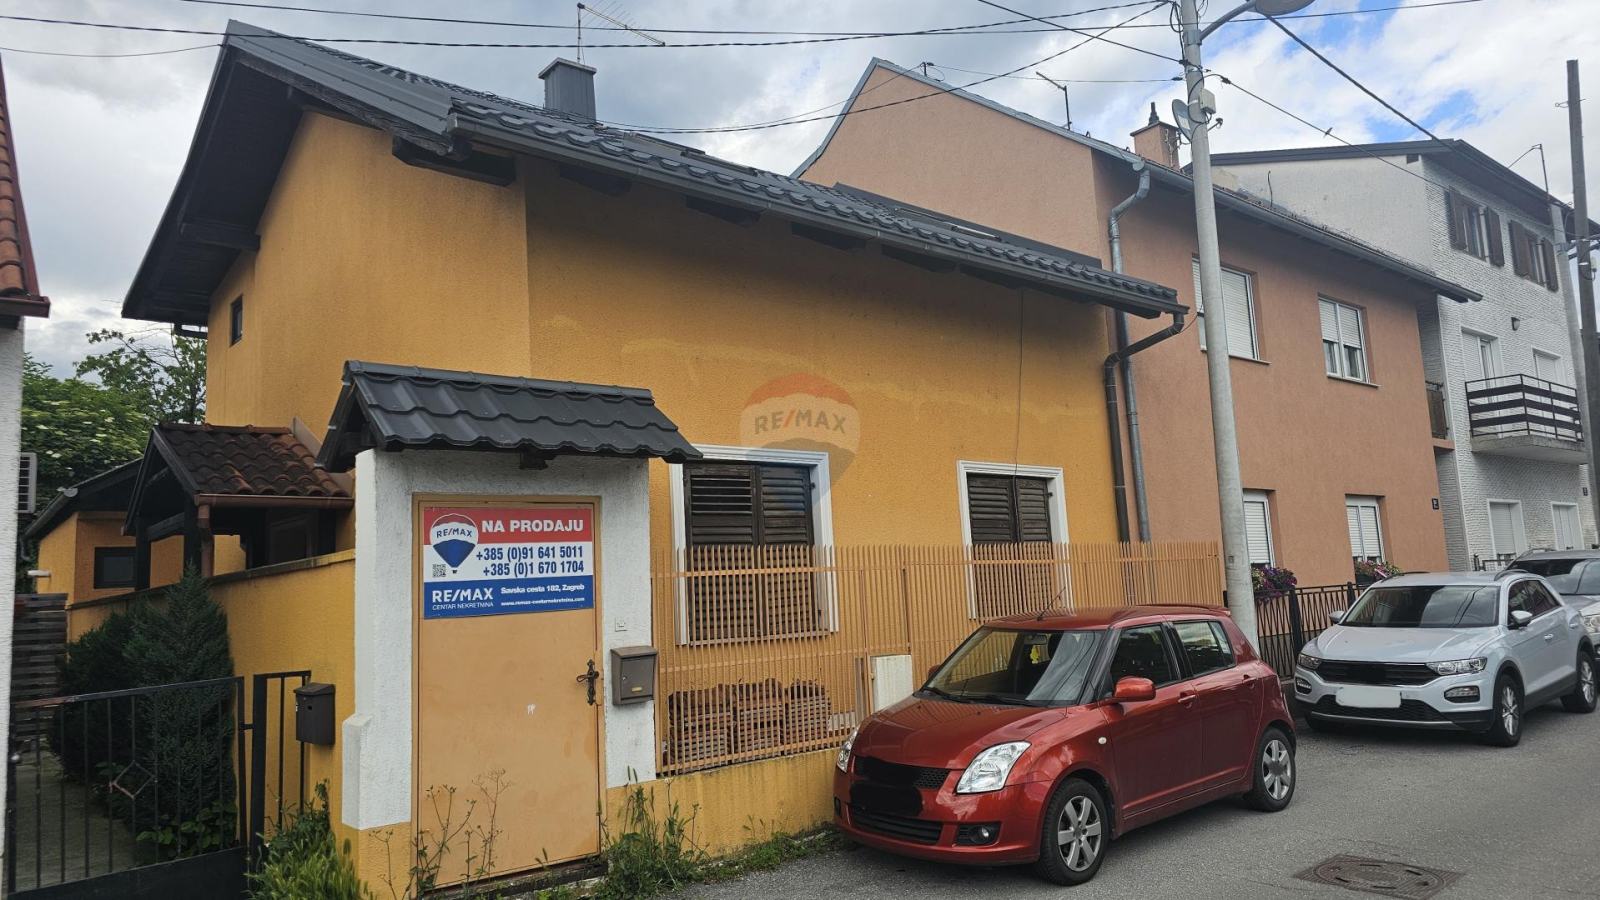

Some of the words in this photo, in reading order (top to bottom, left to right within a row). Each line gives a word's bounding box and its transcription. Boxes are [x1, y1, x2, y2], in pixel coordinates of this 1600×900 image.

[436, 527, 473, 539] RE/MAX
[482, 520, 505, 533] NA
[510, 519, 584, 533] PRODAJU
[476, 547, 503, 561] +385
[507, 546, 533, 562] (0)91
[538, 546, 556, 559] 641
[560, 545, 583, 558] 5011
[483, 562, 510, 576] +385
[514, 561, 534, 578] (0)1
[538, 561, 557, 574] 670
[561, 560, 584, 573] 1704
[432, 587, 494, 603] RE/MAX
[500, 586, 526, 594] Savska
[526, 585, 545, 593] cesta
[562, 583, 585, 592] Zagreb
[432, 603, 456, 611] CENTAR
